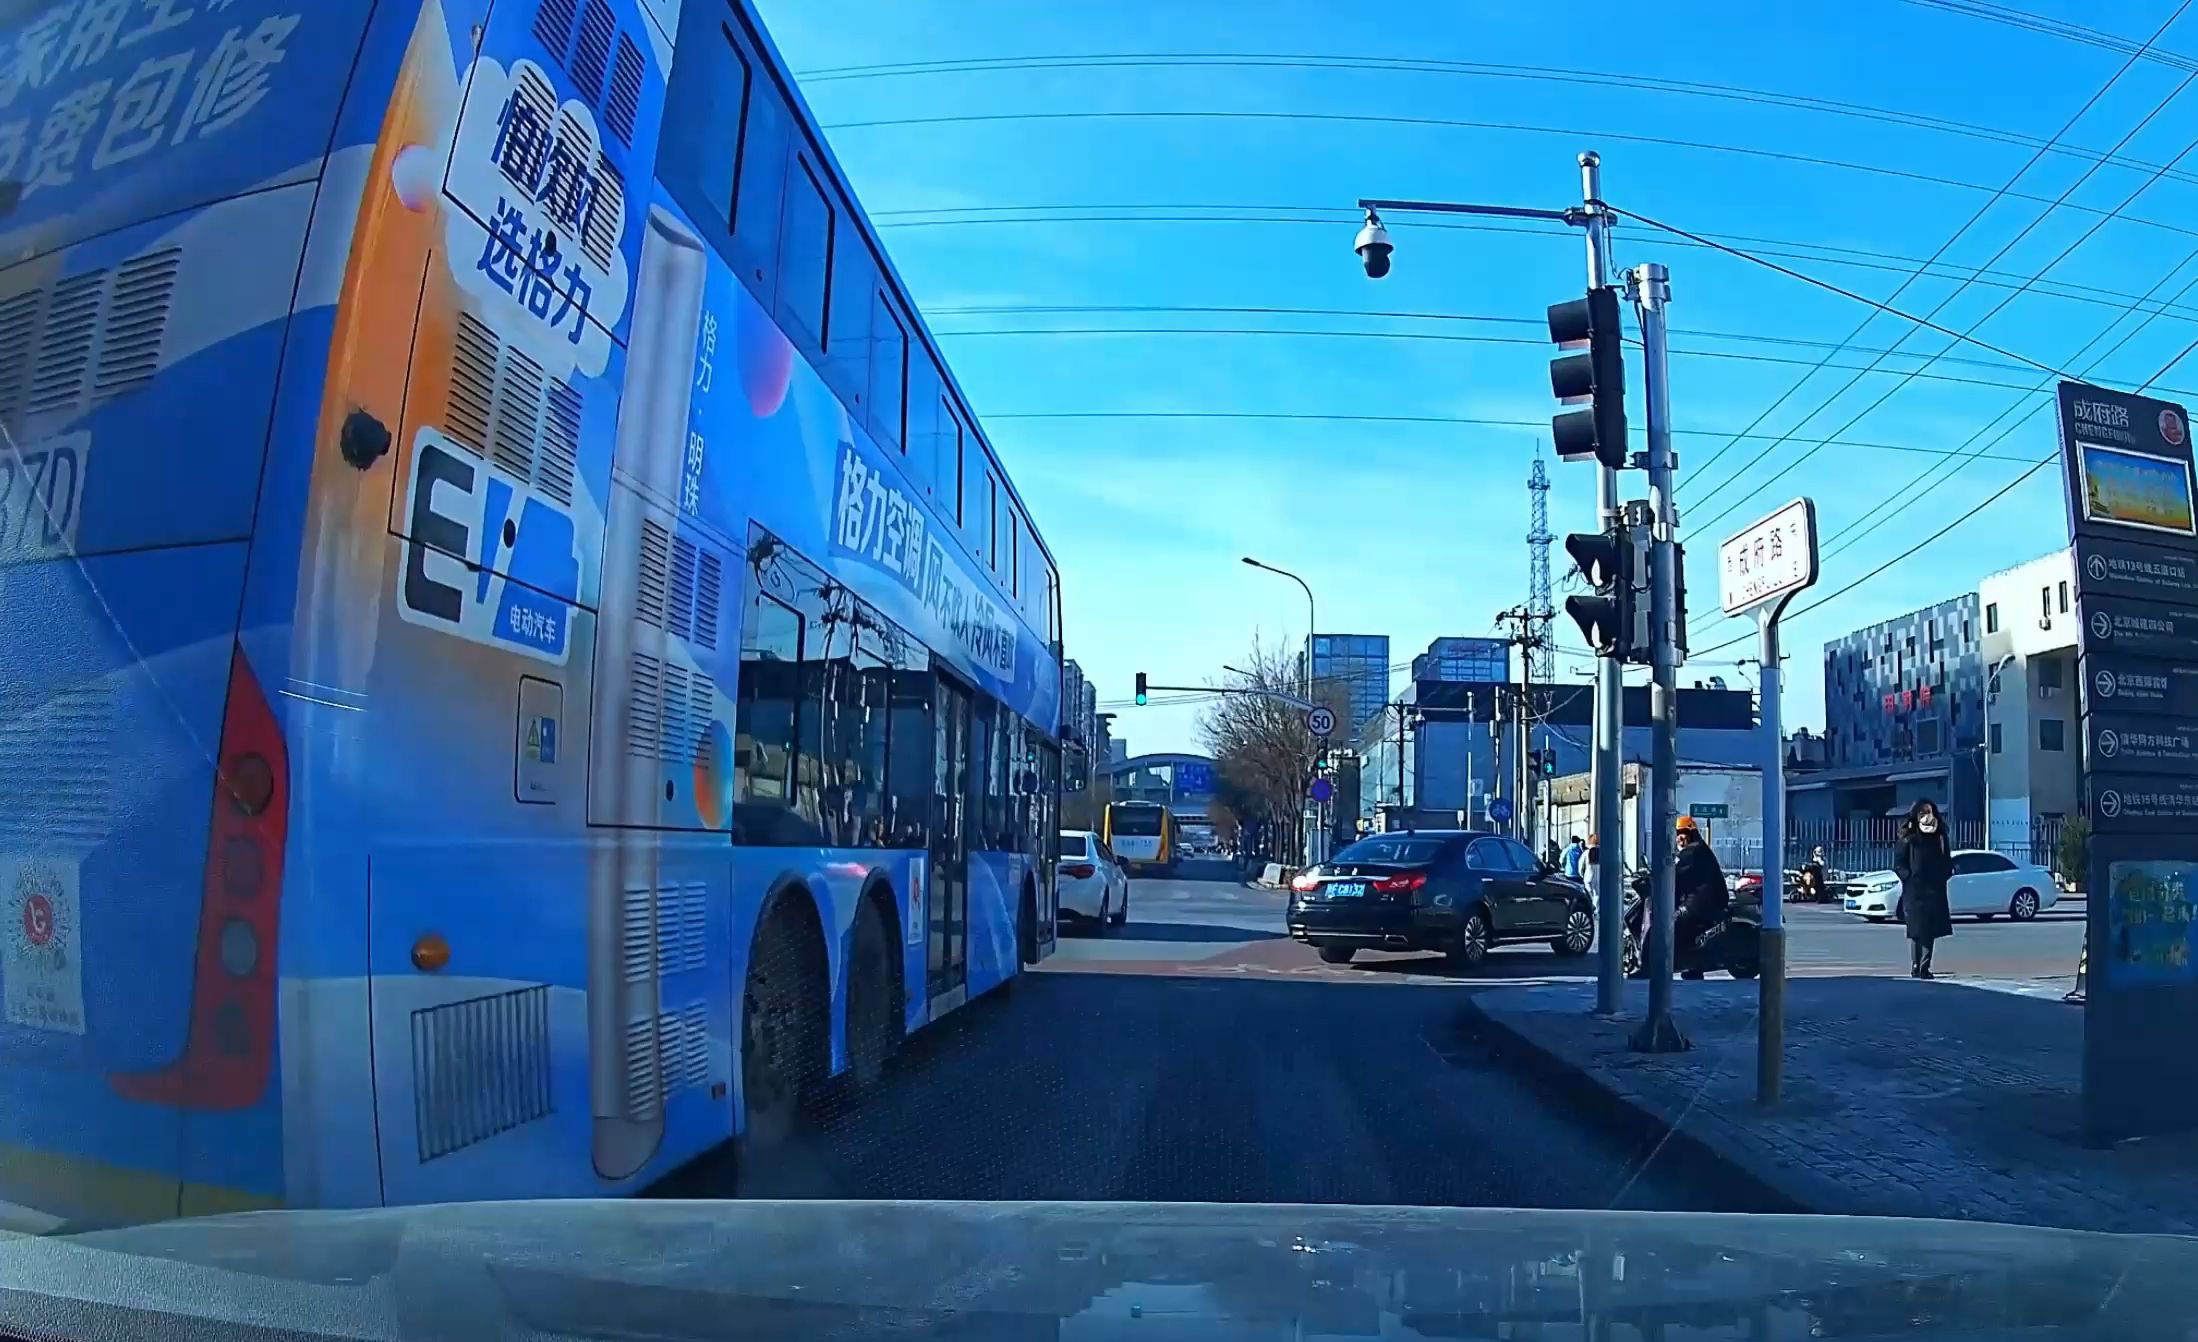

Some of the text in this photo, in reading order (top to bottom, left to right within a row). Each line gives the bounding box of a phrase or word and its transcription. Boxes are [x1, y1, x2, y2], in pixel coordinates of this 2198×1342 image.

[475, 196, 592, 344] 选格力
[2073, 398, 2129, 428] 成府路
[837, 446, 926, 589] 格力空调
[509, 603, 556, 644] 电动汽车
[1312, 715, 1330, 729] 50
